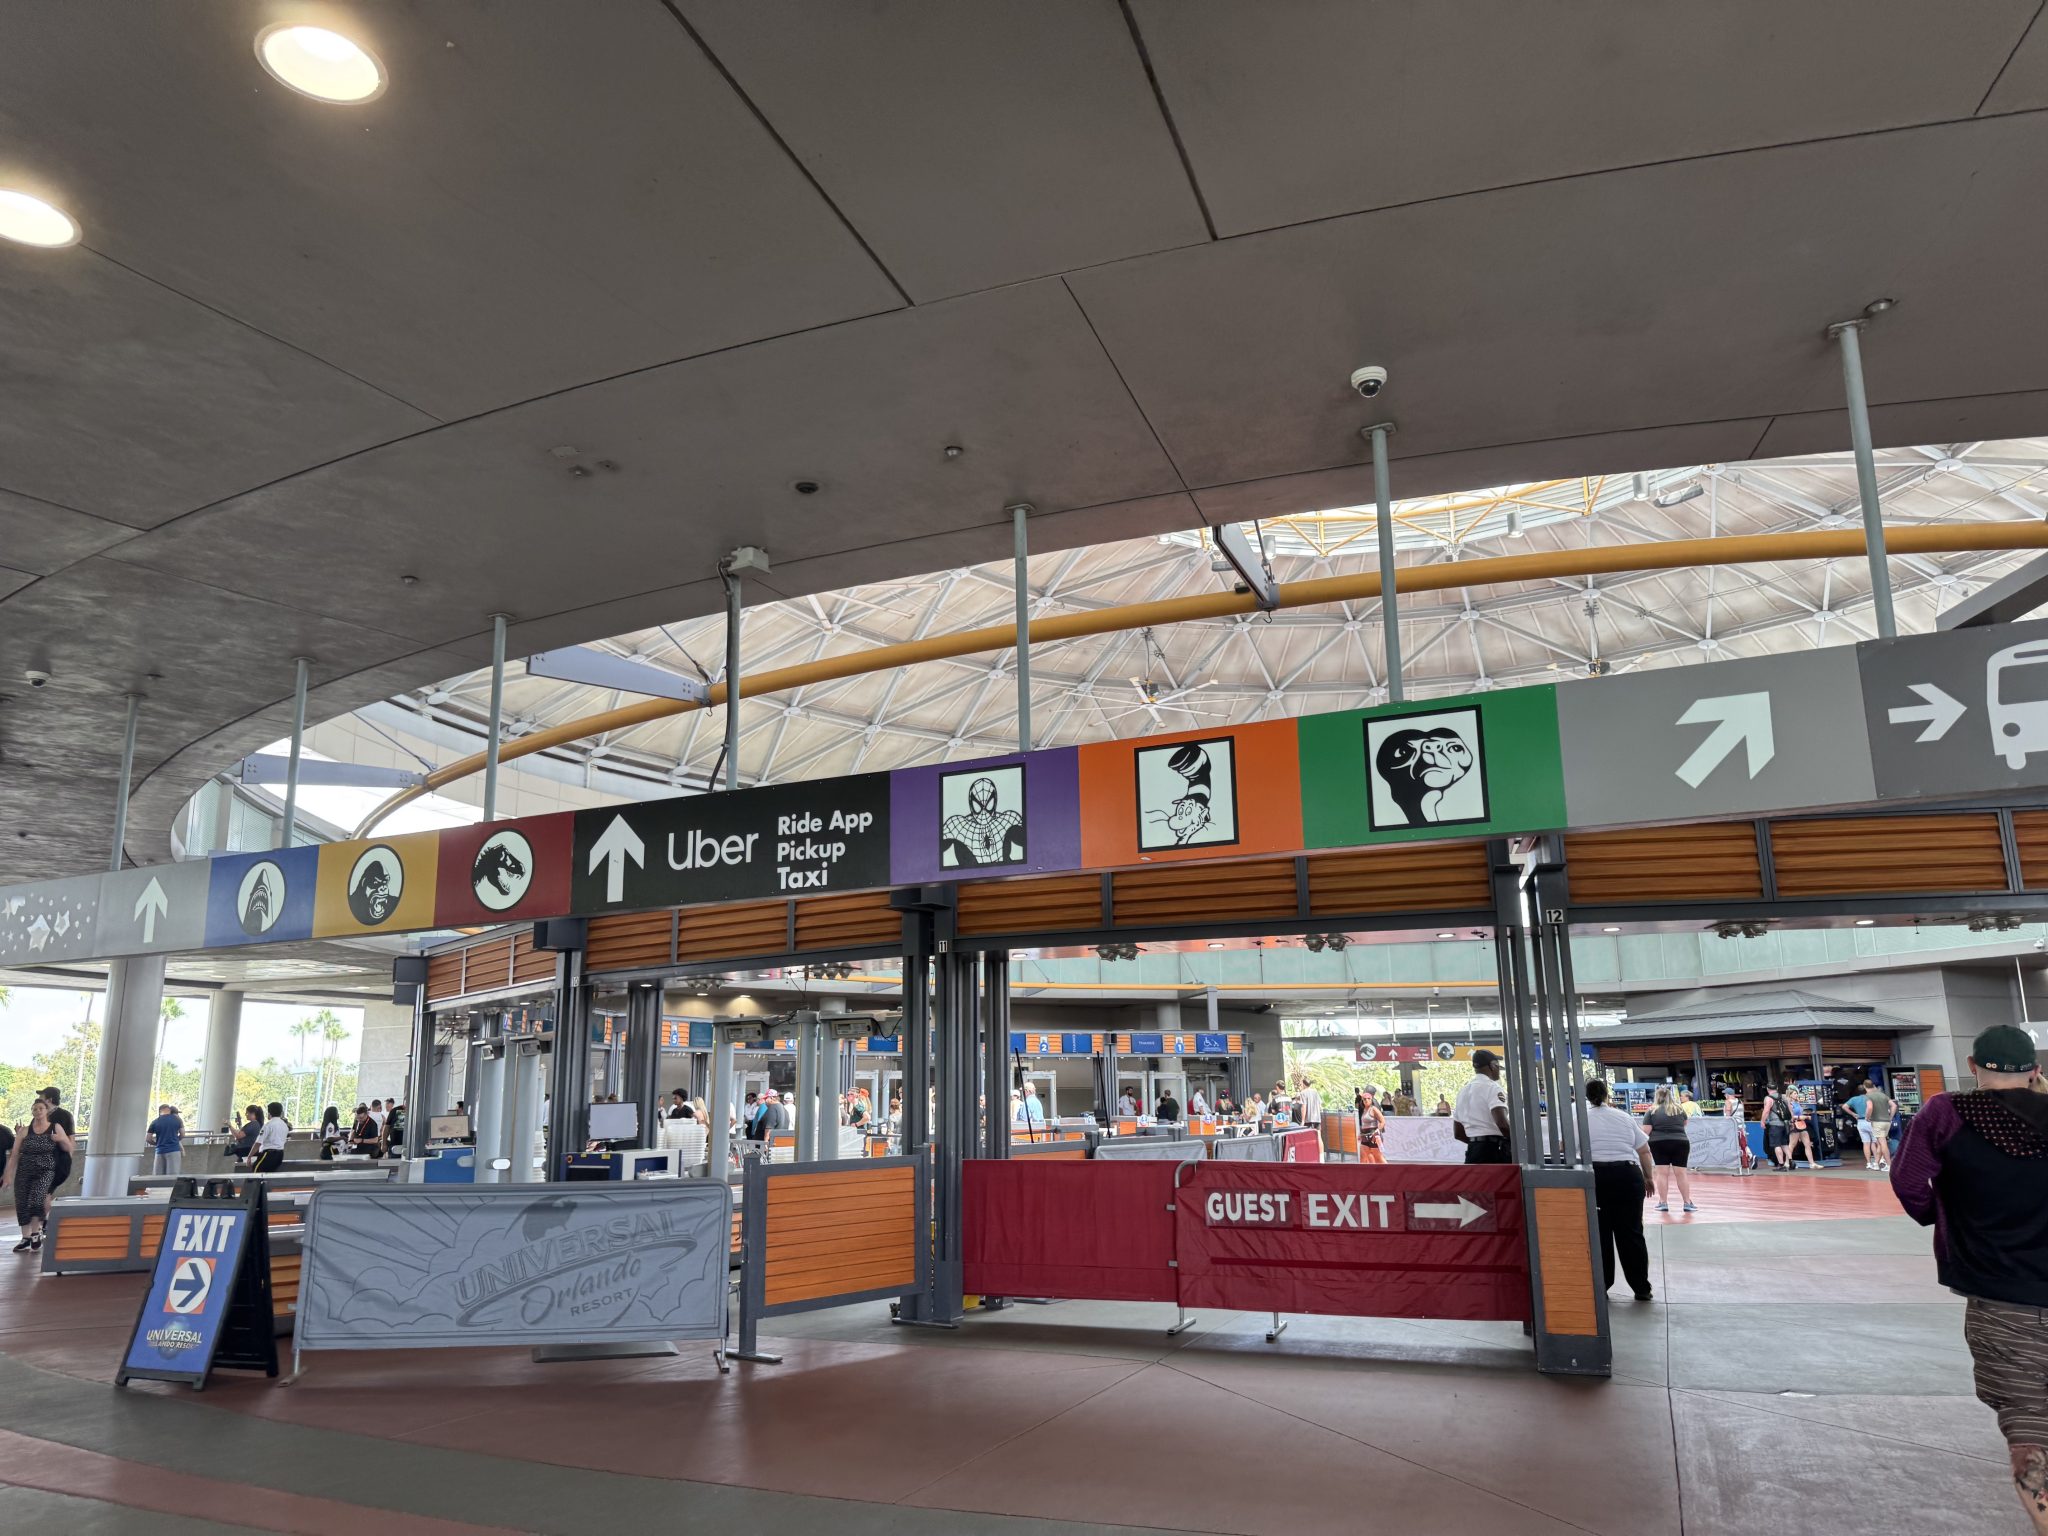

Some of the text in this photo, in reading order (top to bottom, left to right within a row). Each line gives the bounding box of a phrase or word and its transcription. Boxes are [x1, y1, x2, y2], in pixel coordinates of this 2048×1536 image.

[777, 809, 874, 836] Ride App
[668, 829, 760, 871] Uber
[777, 838, 846, 863] Pickup
[777, 861, 828, 890] Taxi
[1547, 910, 1562, 923] 12
[939, 941, 948, 953] 11
[1207, 1192, 1396, 1228] GUEST EXIT
[172, 1215, 236, 1252] EXIT
[454, 1209, 689, 1309] UNIVERSAL
[520, 1250, 642, 1325] Orlando
[570, 1288, 633, 1317] RESORT
[147, 1328, 202, 1344] UNIVERSAL
